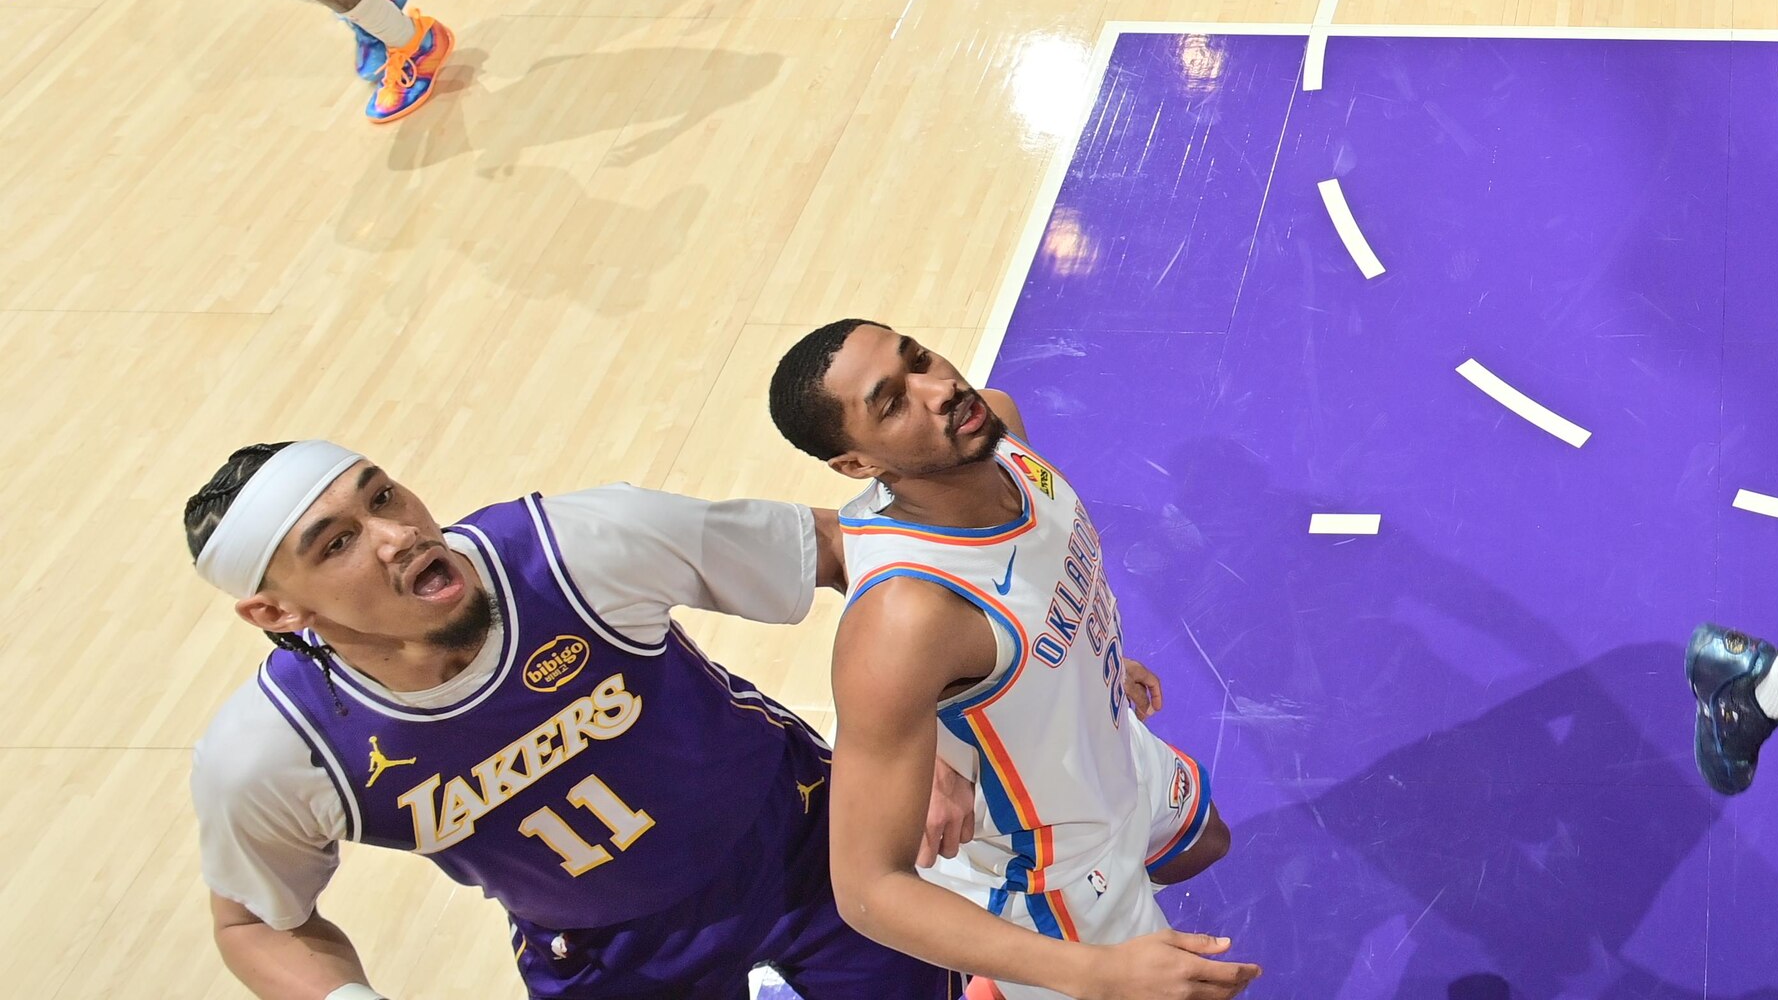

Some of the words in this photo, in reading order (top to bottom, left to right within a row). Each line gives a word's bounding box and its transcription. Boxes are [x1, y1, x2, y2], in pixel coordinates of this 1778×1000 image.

[527, 642, 584, 683] bibigo
[397, 673, 643, 854] LAKERS
[517, 774, 657, 878] 11
